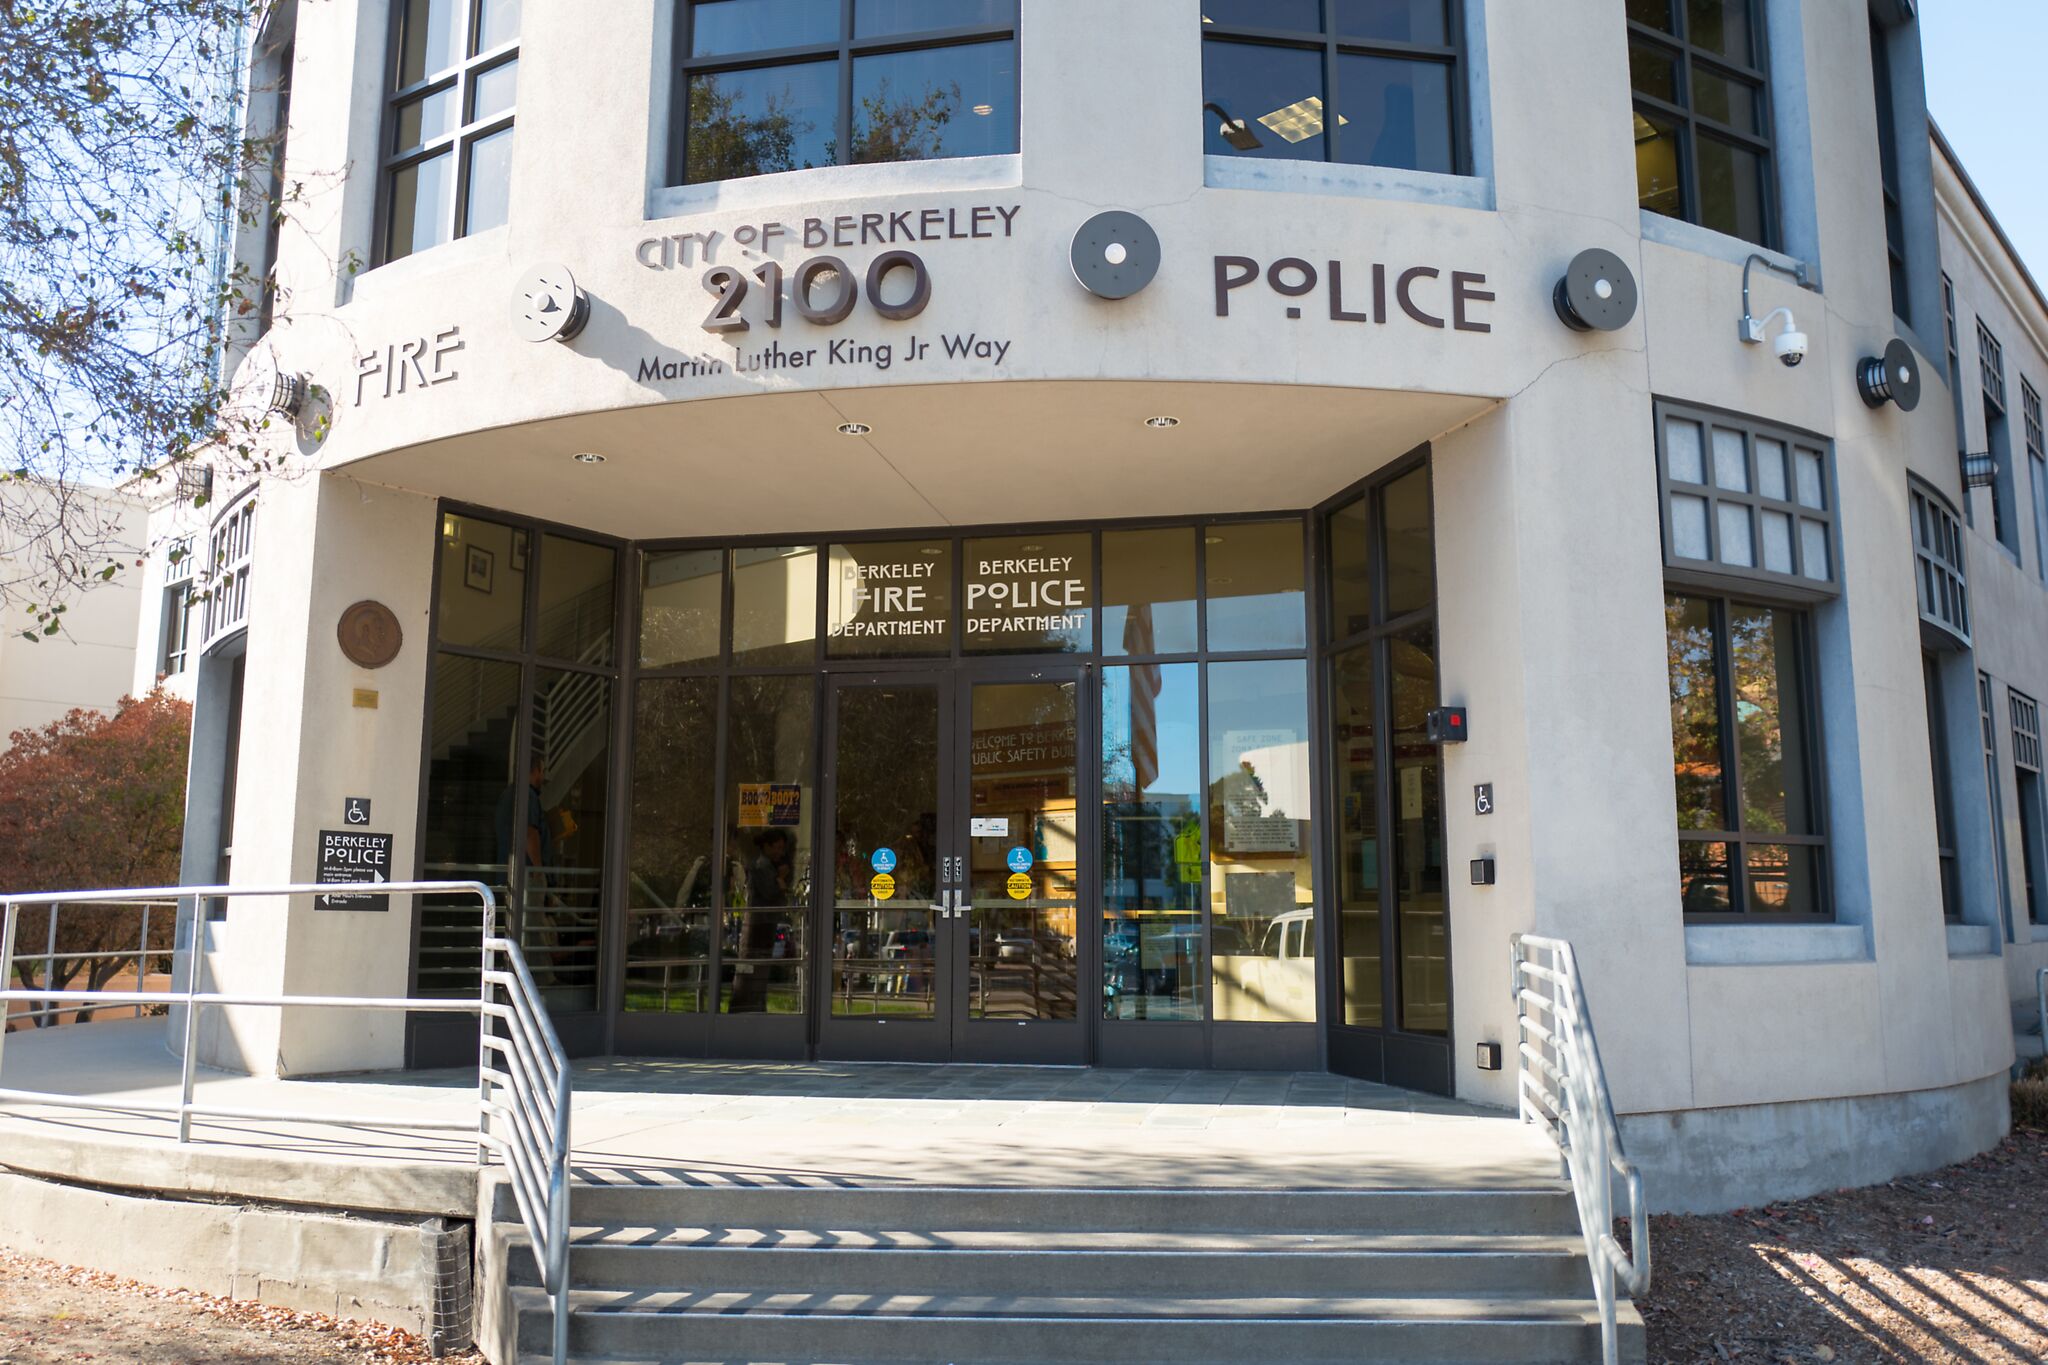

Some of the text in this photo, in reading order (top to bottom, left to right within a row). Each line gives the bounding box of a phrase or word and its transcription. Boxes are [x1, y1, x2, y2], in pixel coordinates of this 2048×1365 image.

[635, 204, 1022, 269] CITY OF BERKELEY
[700, 249, 932, 334] 2100
[1213, 254, 1496, 334] POLICE
[354, 323, 466, 408] FIRE
[636, 332, 1012, 382] Martin Luther King Jr Way
[844, 562, 935, 581] BERKELEY
[979, 556, 1073, 576] BERKELEY
[851, 585, 927, 614] FIRE
[967, 578, 1086, 610] POLICE
[832, 619, 946, 638] DEPARTMENT
[966, 614, 1086, 634] DEPARTMENT
[1020, 733, 1034, 745] TO
[1007, 747, 1047, 763] SAFETY
[325, 835, 387, 849] BERKELEY
[324, 848, 386, 865] POLICE
